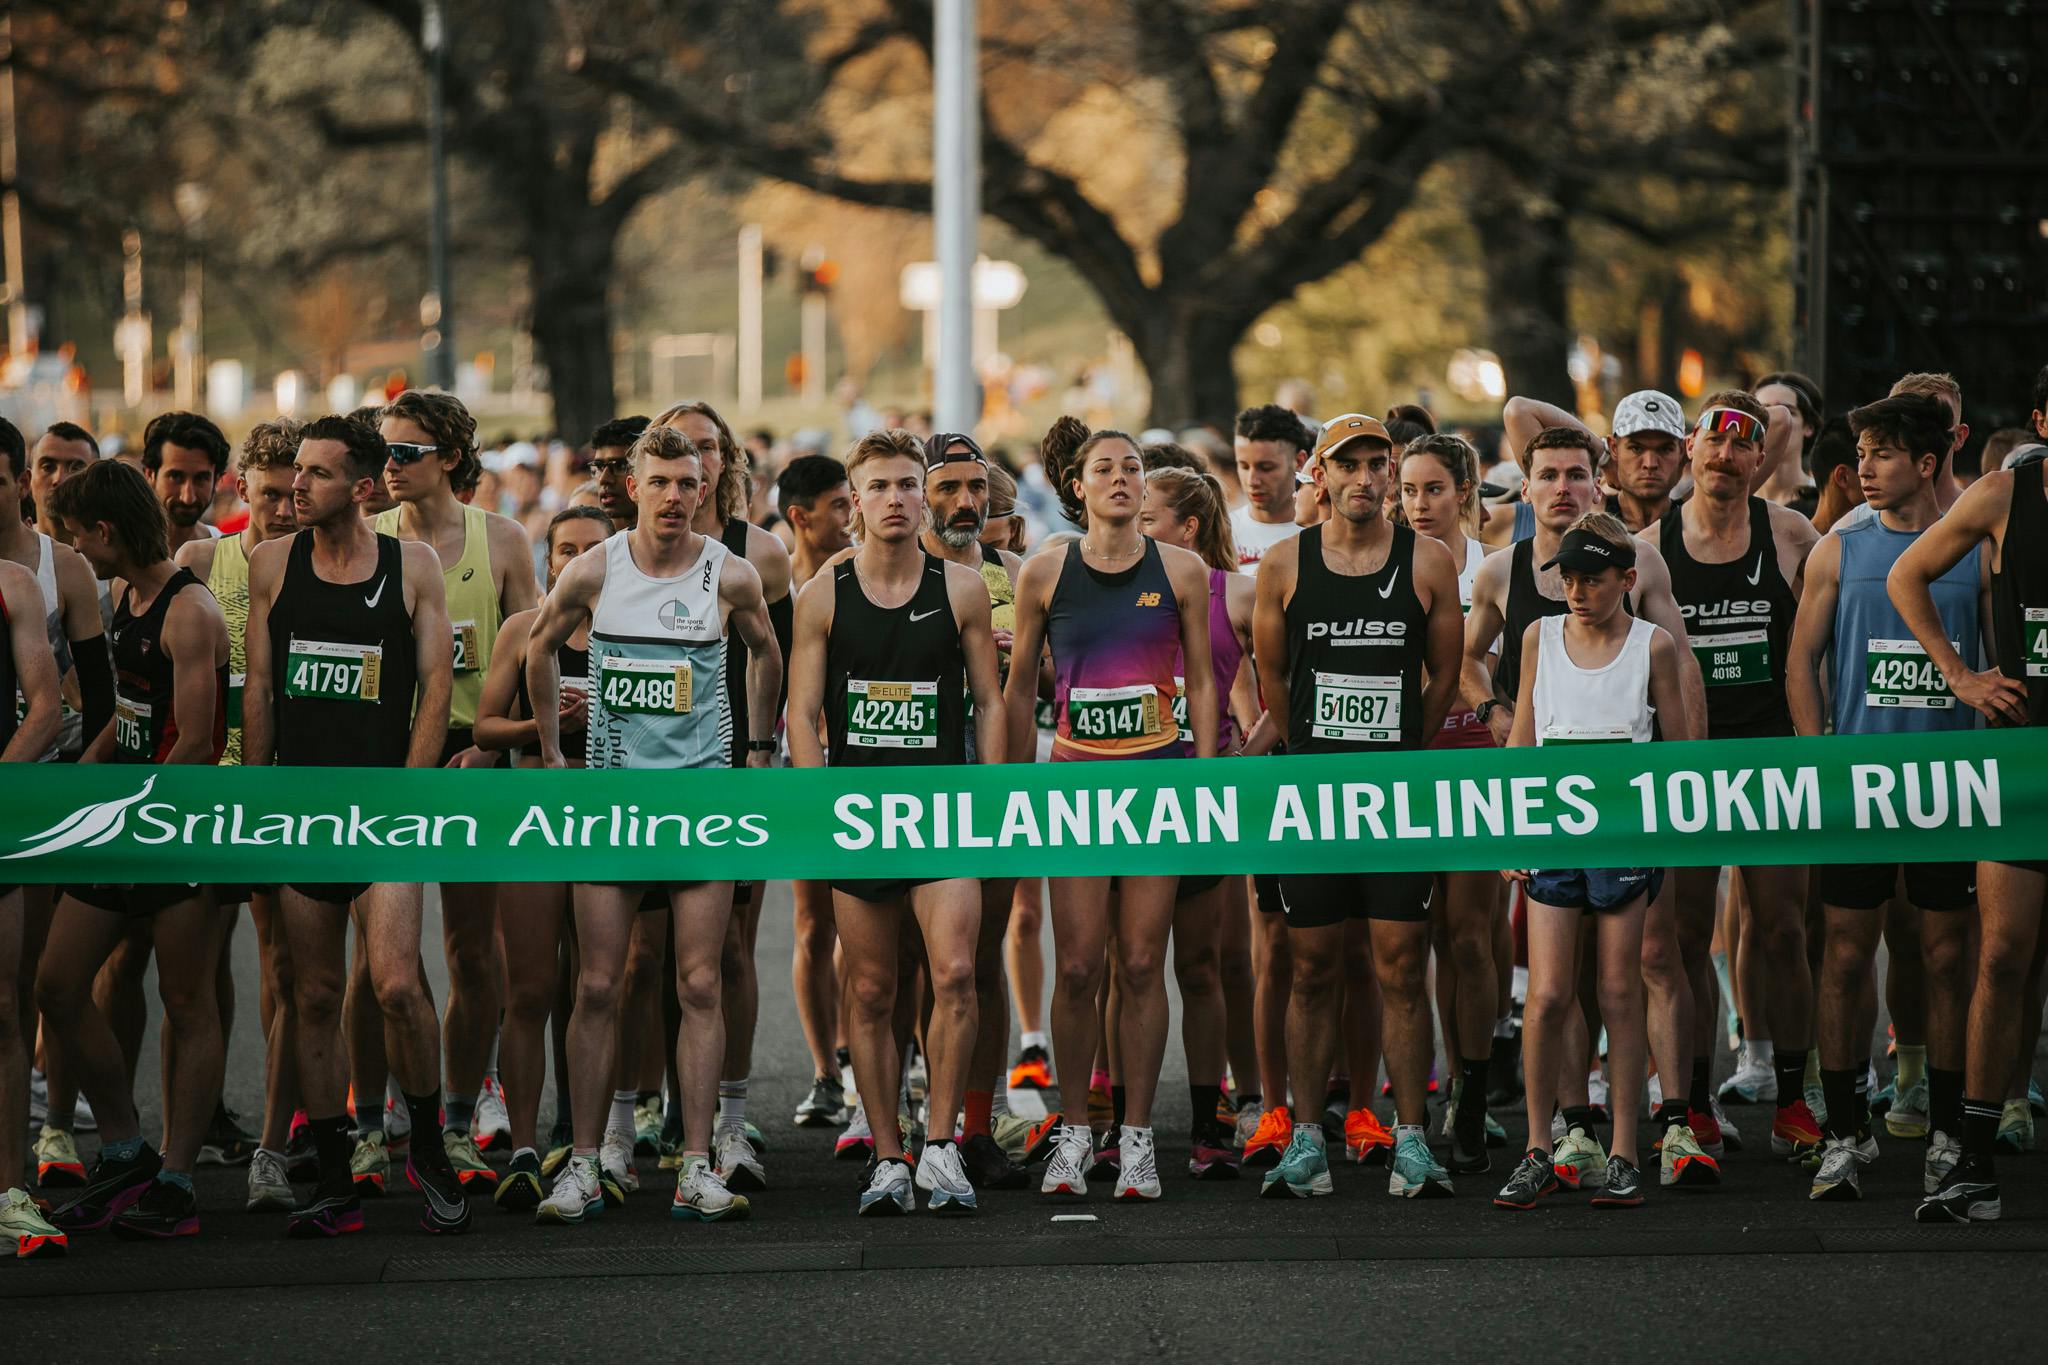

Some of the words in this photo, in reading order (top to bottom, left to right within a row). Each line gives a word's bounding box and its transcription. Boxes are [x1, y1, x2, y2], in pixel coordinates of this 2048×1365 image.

[1583, 544, 1610, 557] 2XU
[702, 559, 713, 593] 2XU
[1307, 618, 1407, 640] pulse
[366, 655, 376, 684] ELITE
[1712, 666, 1742, 679] 40183
[1713, 651, 1738, 665] BEAU
[292, 661, 363, 695] 41797
[1871, 660, 1947, 691] 42943
[604, 676, 676, 709] 42489
[679, 682, 688, 710] ELITE
[882, 687, 910, 697] ELITE
[851, 700, 924, 731] 42245
[1077, 703, 1144, 735] 43147
[1146, 706, 1156, 732] ELITE
[1321, 692, 1389, 724] 51687
[833, 787, 1239, 850] SRILANKAN
[1270, 776, 1598, 841] AIRLINES
[1630, 767, 1821, 833] 10KM
[1852, 758, 2001, 829] RUN
[134, 804, 476, 846] SriLankan
[510, 804, 768, 846] Airlines
